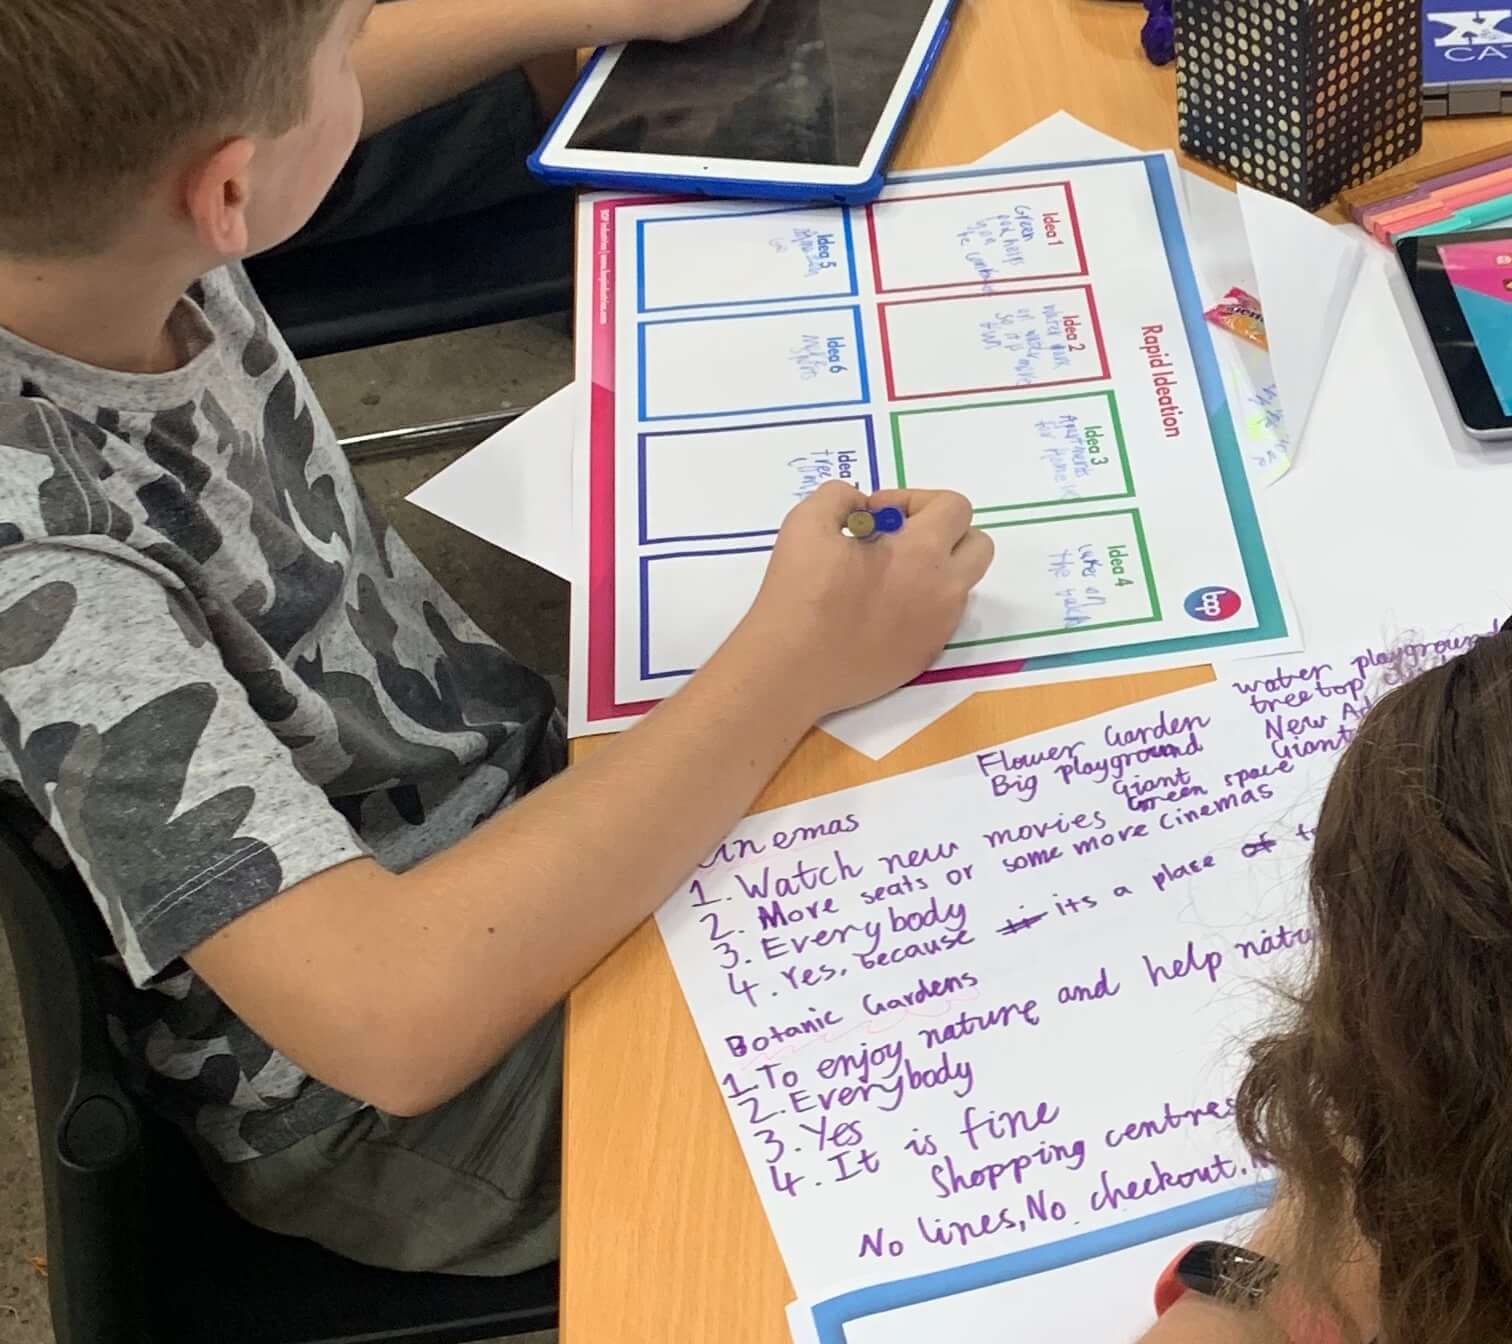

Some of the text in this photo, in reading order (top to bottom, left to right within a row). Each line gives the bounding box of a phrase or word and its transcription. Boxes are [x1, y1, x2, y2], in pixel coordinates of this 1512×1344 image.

[1040, 211, 1060, 238] Idea
[817, 233, 838, 270] Idea 5
[826, 335, 849, 375] Idea 6
[1061, 314, 1086, 353] Idea 2
[1140, 323, 1181, 439] Rapid Ideation
[836, 449, 858, 480] Idea
[1083, 425, 1109, 467] Idea 3
[1106, 543, 1135, 588] Idea 4
[975, 709, 1212, 778] Flower Garden
[1264, 713, 1329, 742] New
[989, 731, 1205, 803] Big playground
[1112, 766, 1192, 801] Giant
[733, 848, 865, 901] Watch
[877, 840, 960, 876] new
[983, 808, 1108, 850] movies
[757, 896, 841, 932] More
[859, 873, 931, 906] seats
[945, 862, 975, 888] or
[1001, 843, 1066, 875] some
[1072, 822, 1150, 858] more
[857, 928, 977, 972] because
[1051, 891, 1100, 918] its
[1111, 883, 1135, 900] a
[1150, 854, 1219, 893] place
[724, 971, 980, 1058] Botanic Gardens
[754, 1061, 799, 1090] To
[816, 1040, 904, 1084] enjoy
[917, 1000, 1041, 1049] nature
[1056, 967, 1121, 1004] and
[1141, 940, 1224, 987] help
[798, 1114, 864, 1152] Yes
[826, 1148, 881, 1183] It
[903, 1127, 939, 1156] is
[959, 1101, 1061, 1151] fine
[858, 1227, 905, 1258] No
